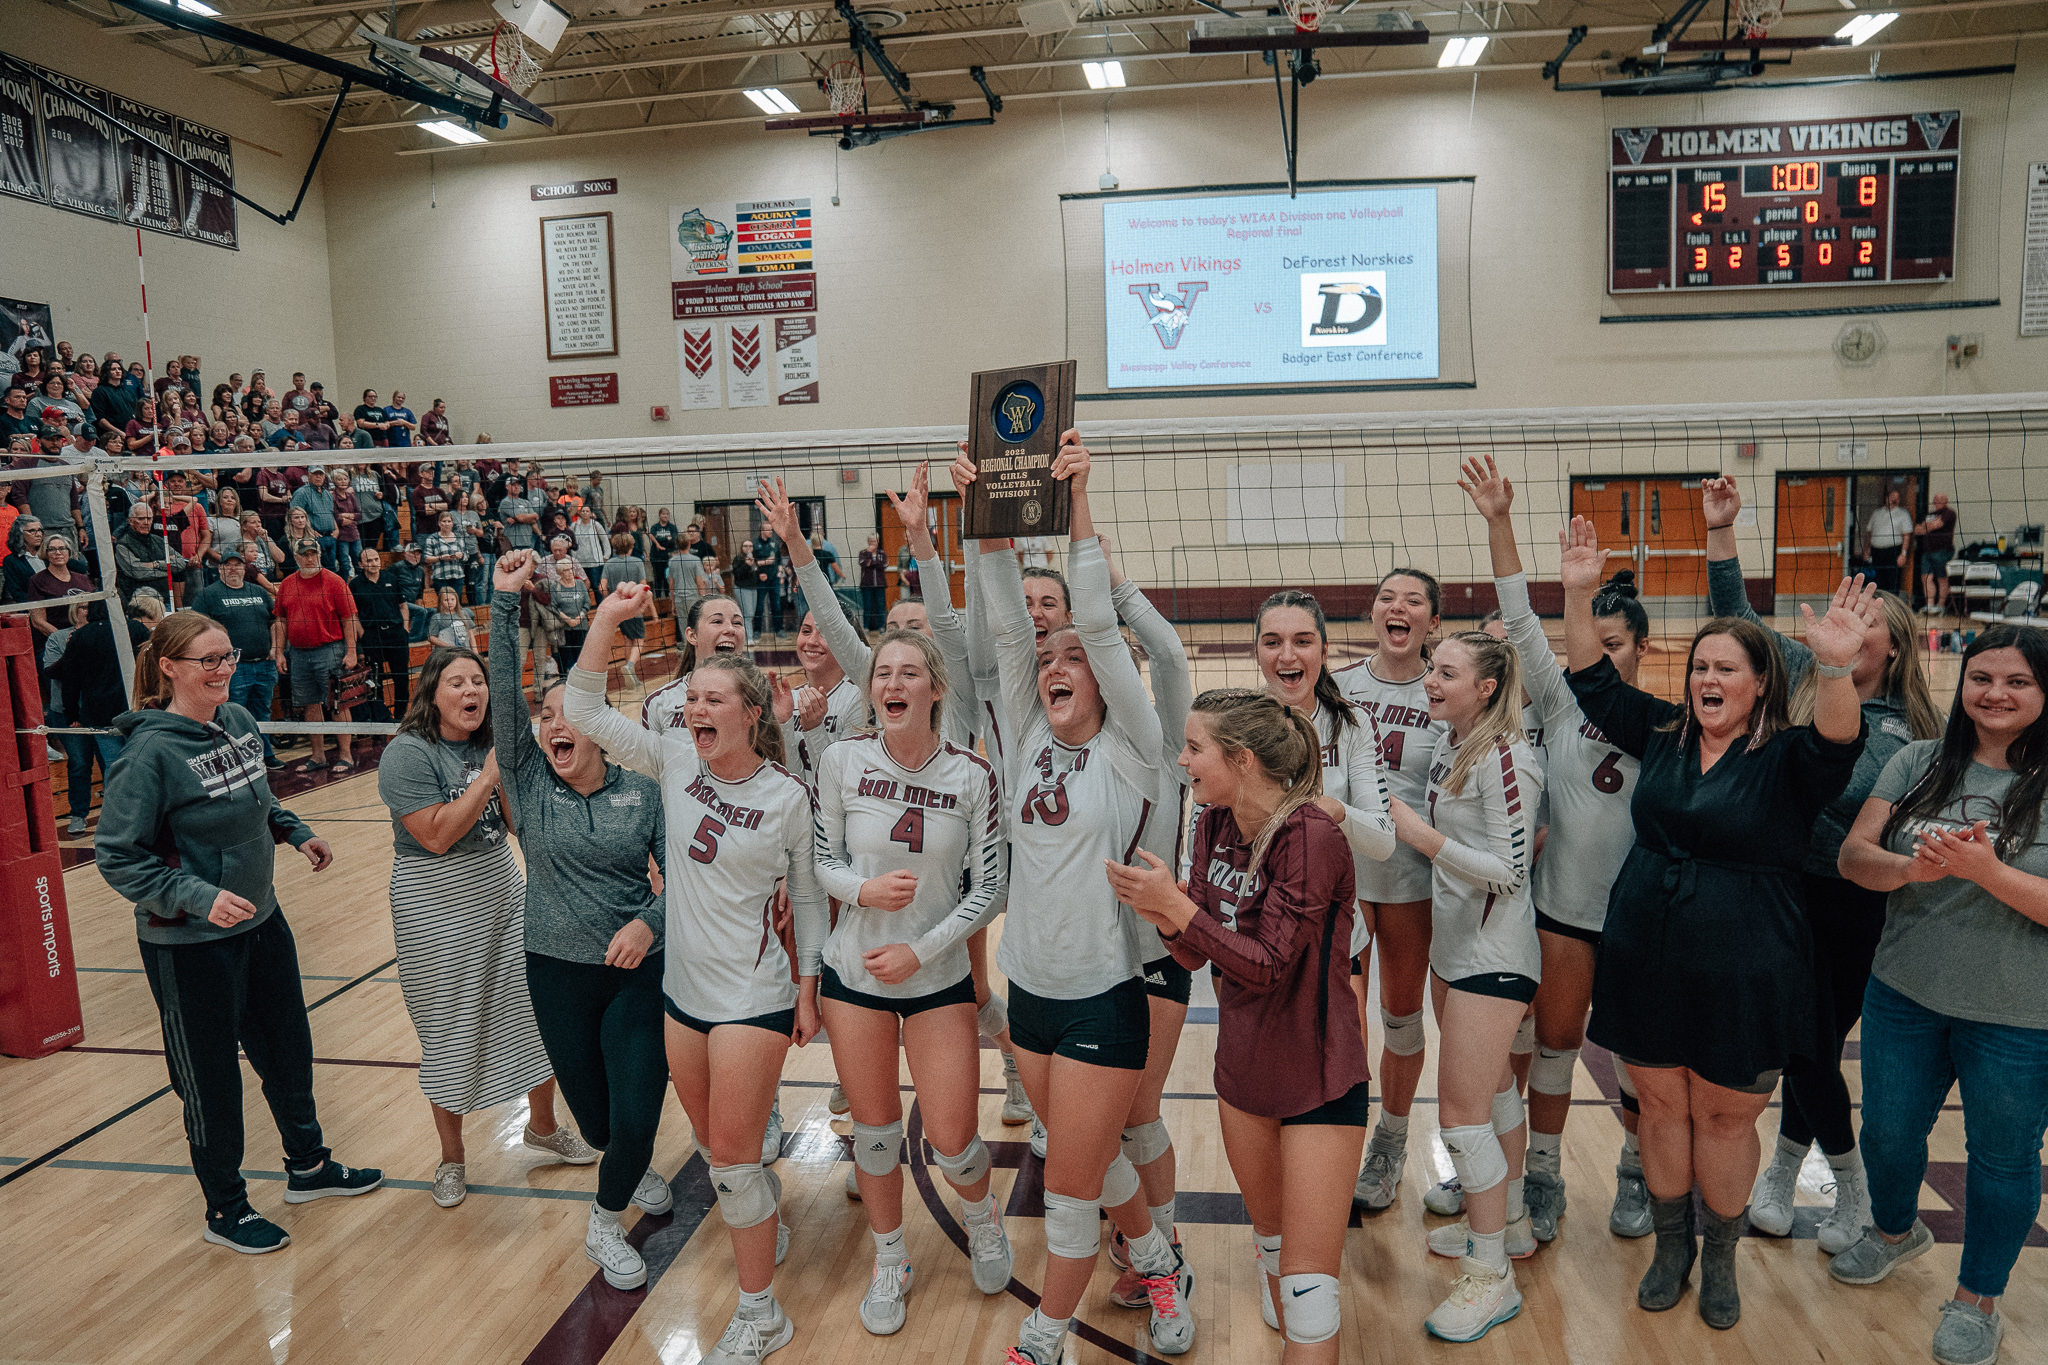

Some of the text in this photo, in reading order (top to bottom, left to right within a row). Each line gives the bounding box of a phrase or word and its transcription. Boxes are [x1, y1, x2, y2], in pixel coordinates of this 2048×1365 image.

[120, 99, 167, 124] MVC
[51, 128, 72, 143] 2018
[183, 121, 226, 145] MVC
[1660, 120, 1909, 158] HOLMEN VIKINGS
[180, 138, 232, 179] CHAMPIONS
[1694, 168, 1722, 184] Home
[1772, 161, 1820, 192] 1:00
[1841, 161, 1878, 177] Guests
[536, 181, 612, 198] SCHOOL SONG
[1703, 182, 1727, 212] 15
[1859, 176, 1878, 206] 8
[67, 197, 106, 215] VIKINGS
[752, 201, 796, 210] HOLMEN
[1804, 200, 1819, 223] 0
[1128, 206, 1404, 230] Welcome to today's WIAA Division one Volleyball
[1765, 206, 1798, 223] period
[138, 216, 172, 231] VIKINGS
[1851, 225, 1877, 239] fouls
[198, 229, 228, 244] VIKINGS
[754, 232, 796, 241] LOGAN
[1226, 224, 1303, 241] Regional final
[1686, 232, 1711, 246] fouls
[1763, 228, 1798, 244] player
[747, 242, 803, 252] ONALASKA
[1776, 244, 1791, 267] 5
[1818, 242, 1833, 266] 0
[1858, 241, 1873, 264] 2
[689, 260, 731, 271] CONFERENCE
[755, 253, 796, 262] SPARTA
[1111, 255, 1242, 276] Holmen Vikings
[1282, 252, 1414, 270] DeForest Norskies
[1694, 247, 1708, 270] 3
[1728, 246, 1743, 269] 2
[755, 263, 796, 272] TOMAH
[1766, 269, 1794, 283] game
[1852, 266, 1874, 278] won
[1688, 271, 1710, 284] won
[705, 280, 783, 294] Holmen High School
[685, 297, 704, 305] PROUD
[706, 296, 714, 304] TO
[715, 295, 739, 304] SUPPORT
[741, 293, 766, 302] POSITIVE
[767, 290, 813, 300] SPORTSMANSHIP
[747, 302, 775, 311] OFFICIALS
[776, 300, 790, 309] AND
[791, 299, 806, 308] FANS
[1171, 360, 1198, 373] Valley
[1199, 358, 1253, 371] Conference
[1281, 348, 1424, 366] Badger East Conference
[783, 362, 811, 372] WRESTLING
[784, 372, 811, 381] HOLMEN
[1004, 449, 1026, 457] 2022
[980, 453, 1050, 473] REGIONAL CHAMPION
[1000, 471, 1028, 481] GIRLS
[985, 479, 1042, 491] VOLLEYBALL
[989, 489, 1038, 500] DIVISION 1
[1591, 750, 1625, 795] 6
[858, 776, 958, 811] HOLMEN
[685, 774, 765, 831] HOLMEN
[890, 806, 925, 854] 4
[688, 814, 727, 865] 5
[35, 876, 61, 978] sports imports
